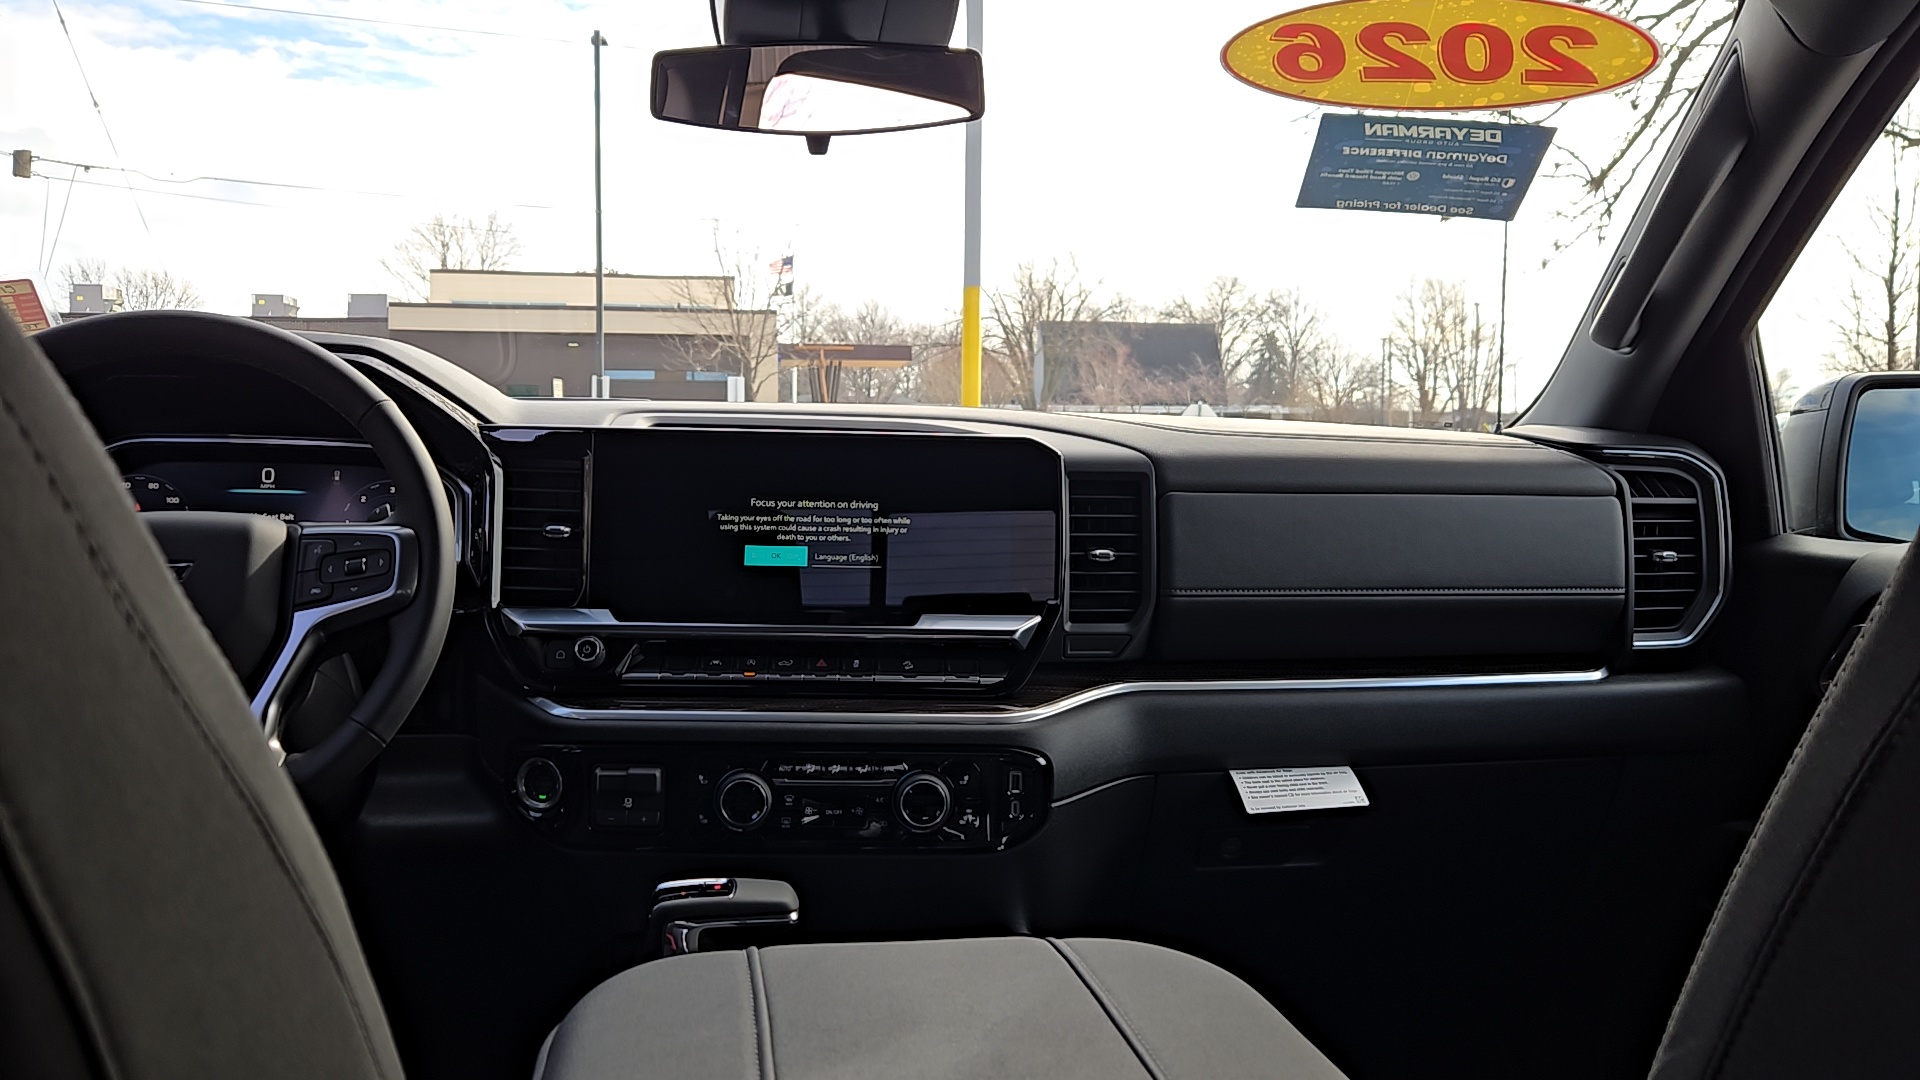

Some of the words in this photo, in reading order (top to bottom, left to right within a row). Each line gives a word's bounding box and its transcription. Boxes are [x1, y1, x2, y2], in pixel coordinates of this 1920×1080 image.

[261, 467, 275, 483] 0
[360, 495, 367, 503] 2
[750, 498, 776, 508] Focus
[777, 500, 795, 510] your
[797, 499, 836, 509] attention
[837, 501, 848, 509] on
[850, 500, 879, 511] driving
[279, 513, 295, 521] Belt
[717, 513, 739, 522] Taking
[740, 515, 755, 523] your
[756, 515, 771, 523] eyes
[773, 514, 784, 522] off
[796, 515, 811, 523] road
[812, 515, 823, 523] for
[836, 516, 852, 525] long
[893, 517, 911, 525] while
[719, 524, 738, 532] using
[739, 523, 752, 531] this
[753, 524, 777, 533] system
[778, 523, 797, 532] could
[797, 525, 817, 533] cause
[823, 525, 842, 533] crash
[842, 525, 872, 535] resulting
[880, 526, 899, 535] injury
[776, 533, 797, 541] death
[827, 534, 851, 542] others.
[770, 552, 782, 560] OK
[814, 553, 848, 562] Language
[849, 553, 879, 563] (English)
